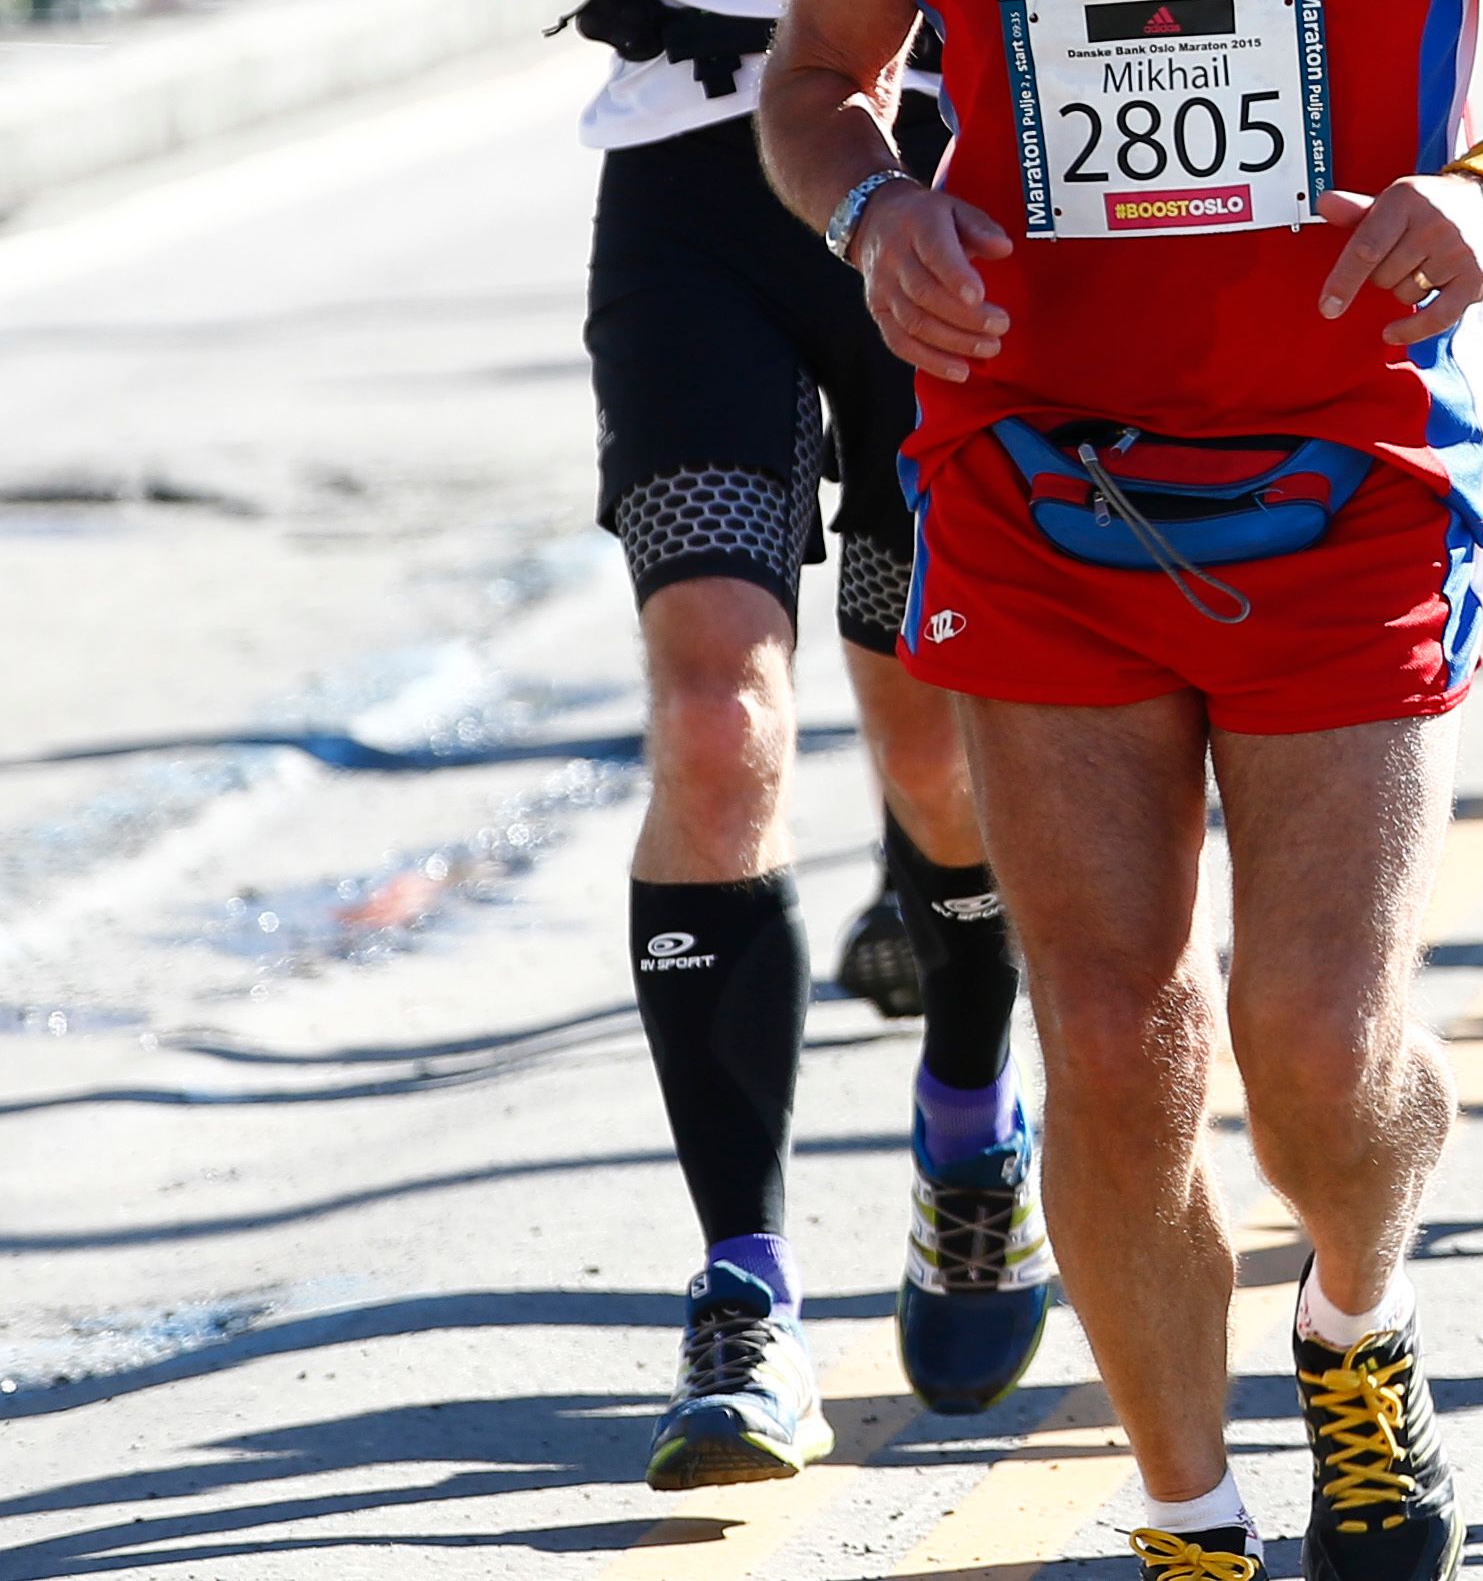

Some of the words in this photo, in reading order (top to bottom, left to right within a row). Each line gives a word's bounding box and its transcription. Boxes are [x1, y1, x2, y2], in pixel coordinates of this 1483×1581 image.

[1143, 24, 1181, 34] adidas
[1012, 40, 1028, 72] start
[1067, 48, 1112, 59] Danske
[1116, 45, 1146, 56] Bank
[1149, 43, 1175, 54] Oslo
[1178, 41, 1228, 52] Maraton
[1231, 38, 1262, 49] 2015
[1102, 54, 1231, 94] Mikhail
[1019, 90, 1036, 126] Pulje
[1307, 84, 1323, 120] Pulje
[1058, 90, 1285, 183] 2805
[1312, 139, 1326, 173] start
[1022, 130, 1047, 225] Maraton
[1114, 194, 1244, 219] #BOOSTOSLO
[657, 953, 717, 971] SPORT
